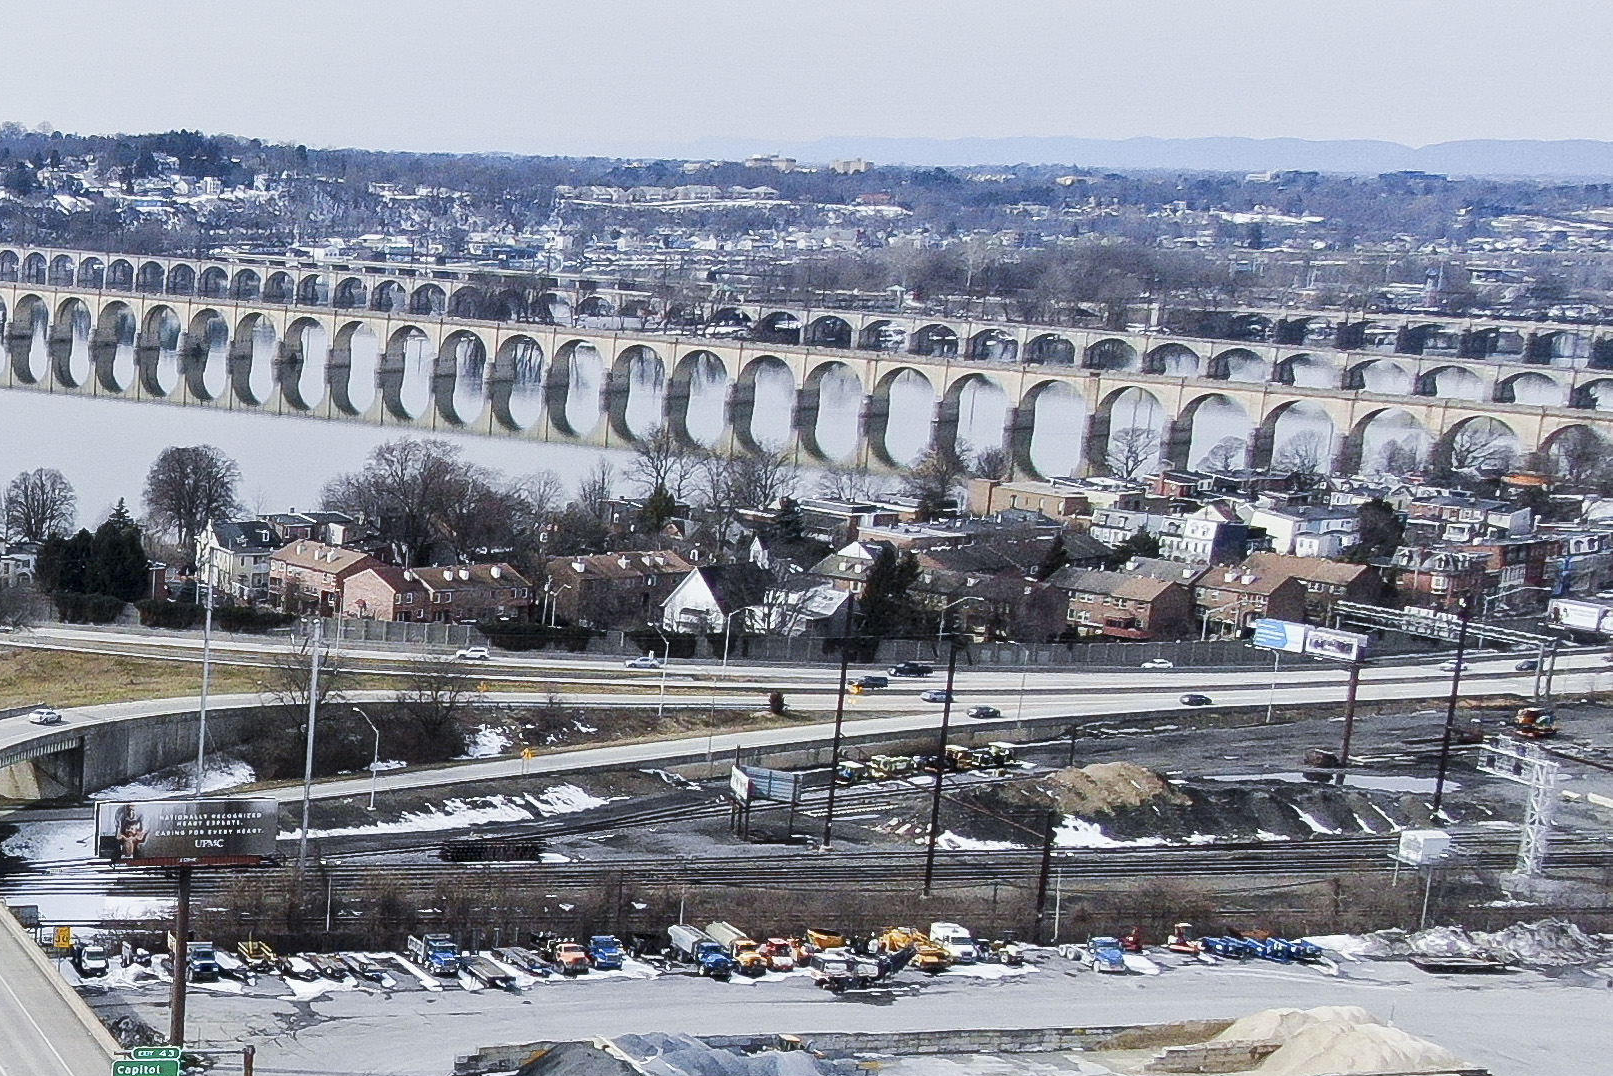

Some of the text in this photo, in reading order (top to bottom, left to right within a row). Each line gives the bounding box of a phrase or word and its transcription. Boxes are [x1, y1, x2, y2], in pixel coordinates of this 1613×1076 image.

[159, 813, 208, 821] NATIONALLY
[155, 829, 185, 837] CARING
[194, 838, 225, 848] UPMC
[159, 1049, 175, 1057] 43
[117, 1064, 161, 1076] Capitol
